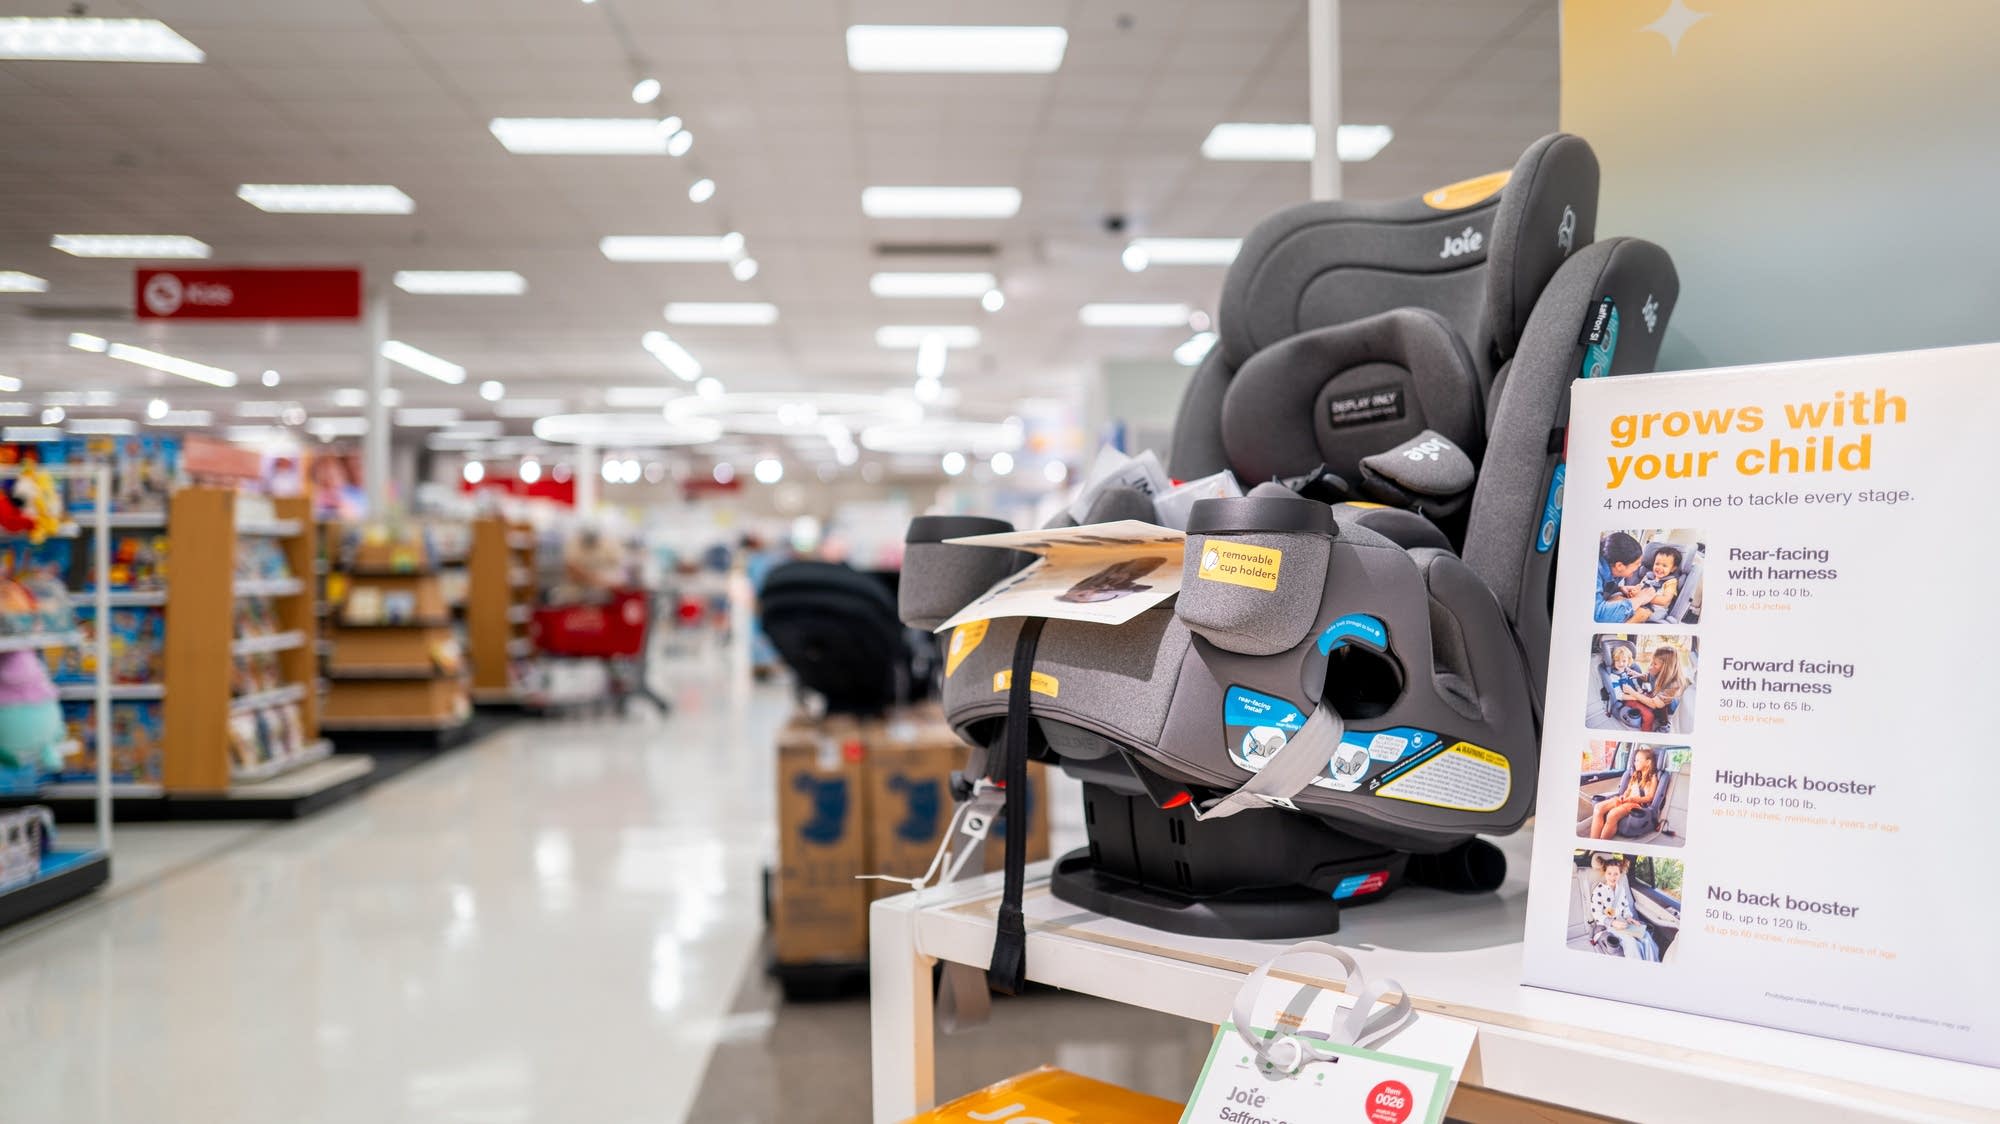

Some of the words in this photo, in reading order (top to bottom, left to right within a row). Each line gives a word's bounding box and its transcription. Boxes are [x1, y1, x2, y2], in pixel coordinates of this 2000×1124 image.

[1440, 226, 1482, 258] Joie
[1332, 397, 1369, 413] DISPLAY
[1372, 392, 1397, 407] ONLY
[1610, 405, 1765, 448] grows
[1784, 388, 1907, 430] with
[1606, 449, 1718, 489] your
[1735, 434, 1872, 475] child
[1603, 498, 1612, 510] 4
[1617, 496, 1669, 510] modes
[1674, 495, 1687, 508] in
[1692, 496, 1722, 508] one
[1727, 494, 1743, 506] to
[1749, 491, 1799, 506] tackle
[1804, 492, 1852, 507] every
[1858, 489, 1915, 505] stage.
[1222, 551, 1273, 566] removable
[1729, 547, 1829, 563] Rear-facing
[1219, 564, 1237, 575] cup
[1239, 565, 1276, 581] holders
[1728, 566, 1763, 580] with
[1767, 566, 1838, 580] harness
[1726, 588, 1733, 597] 4
[1736, 588, 1748, 597] lb.
[1752, 589, 1766, 599] up
[1769, 588, 1779, 597] to
[1783, 588, 1796, 597] 40
[1800, 588, 1813, 597] lb.
[1723, 657, 1794, 672] Forward
[1799, 660, 1854, 678] facing
[1721, 677, 1757, 691] with
[1762, 678, 1832, 694] harness
[1238, 696, 1271, 711] rear-facing
[1244, 703, 1263, 714] install
[1720, 699, 1733, 708] 30
[1736, 699, 1748, 708] lb.
[1752, 700, 1766, 711] up
[1769, 700, 1780, 710] to
[1783, 701, 1797, 711] 65
[1801, 702, 1814, 711] lb.
[1718, 714, 1729, 723] up
[1732, 713, 1741, 722] to
[1715, 770, 1798, 789] Highback
[1803, 776, 1876, 796] booster
[1713, 792, 1727, 802] 40
[1730, 793, 1743, 803] lb.
[1747, 796, 1760, 807] up
[1764, 796, 1775, 806] to
[1780, 797, 1799, 808] 100
[1803, 799, 1817, 810] lb.
[1712, 808, 1723, 817] up
[1725, 808, 1735, 817] to
[1785, 813, 1828, 826] minimum
[1839, 820, 1865, 831] years
[1868, 821, 1878, 830] of
[1881, 823, 1900, 833] age
[1707, 885, 1732, 901] No
[1737, 889, 1780, 908] back
[1786, 895, 1859, 918] booster
[1705, 908, 1719, 919] 50
[1722, 911, 1735, 921] lb.
[1739, 914, 1753, 925] up
[1757, 915, 1768, 925] to
[1773, 918, 1793, 929] 120
[1797, 921, 1811, 932] lb.
[1226, 1086, 1266, 1108] Joie
[1375, 1093, 1405, 1109] 0026
